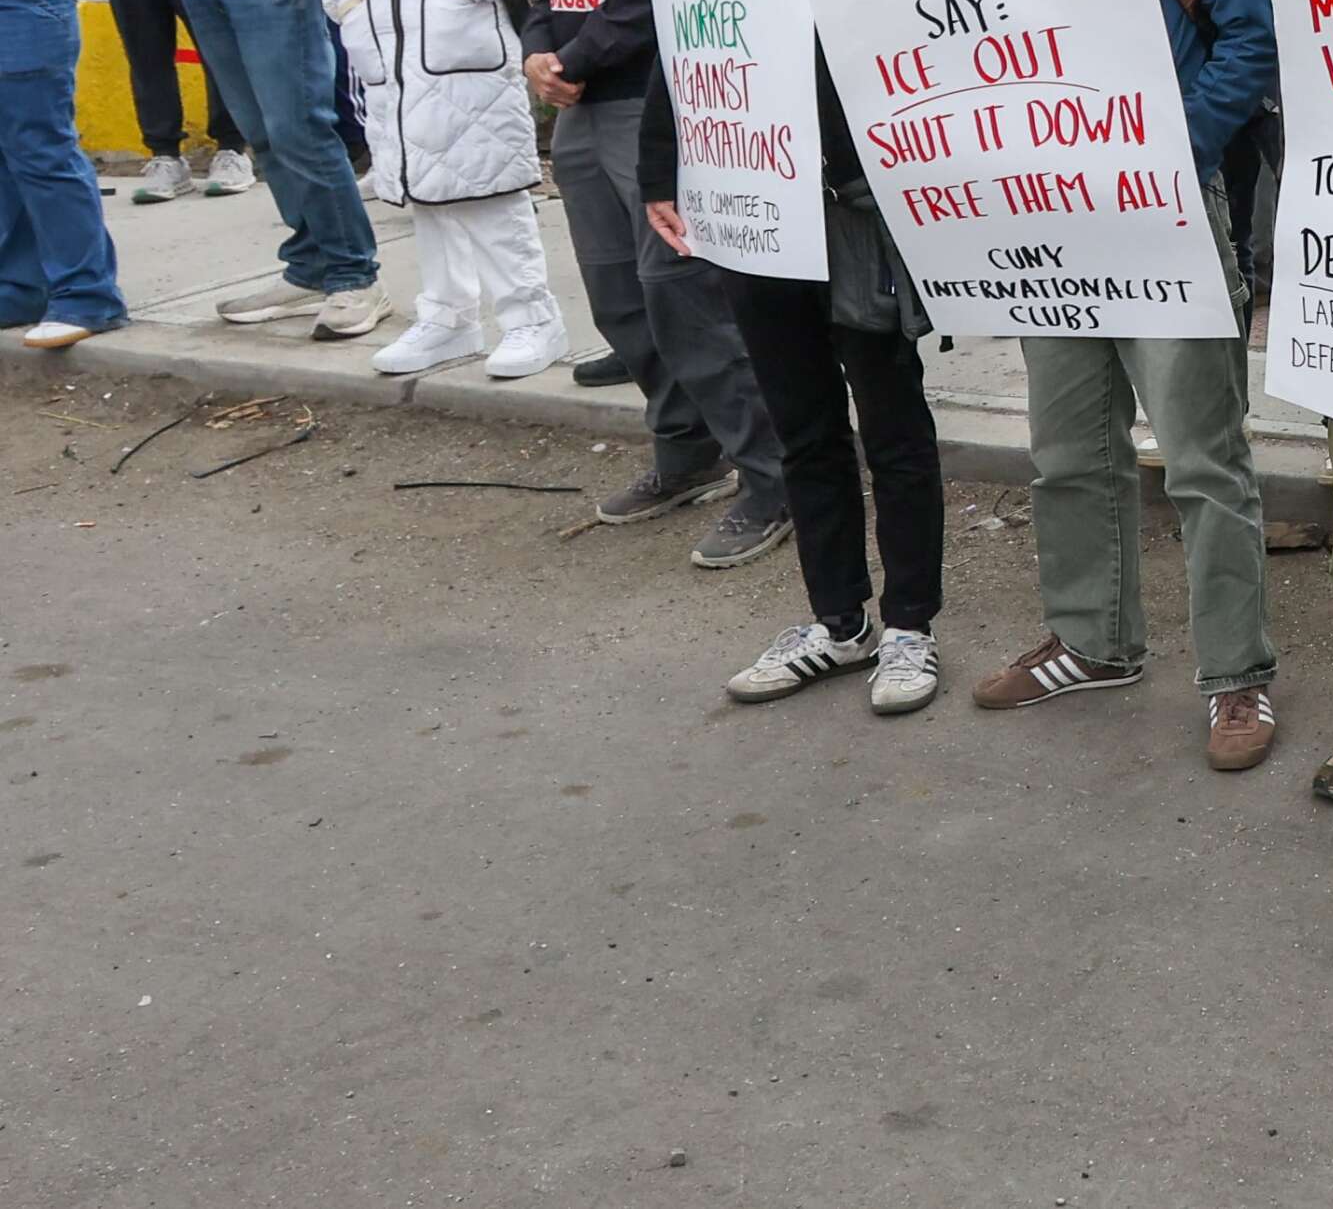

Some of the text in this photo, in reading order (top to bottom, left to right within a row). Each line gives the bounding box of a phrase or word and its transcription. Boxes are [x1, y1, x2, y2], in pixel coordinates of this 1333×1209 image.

[875, 25, 1072, 97] ICE OUT
[672, 57, 758, 114] AGAINST
[866, 92, 1146, 169] SHUT IT DOWN
[711, 191, 760, 218] COMMITTEE
[763, 201, 780, 221] TO
[902, 170, 1188, 228] FREE THEM ALL!
[988, 244, 1064, 271] CUNY
[922, 276, 1193, 304] INTERNATIONALIST
[1009, 304, 1101, 331] CLUBS
